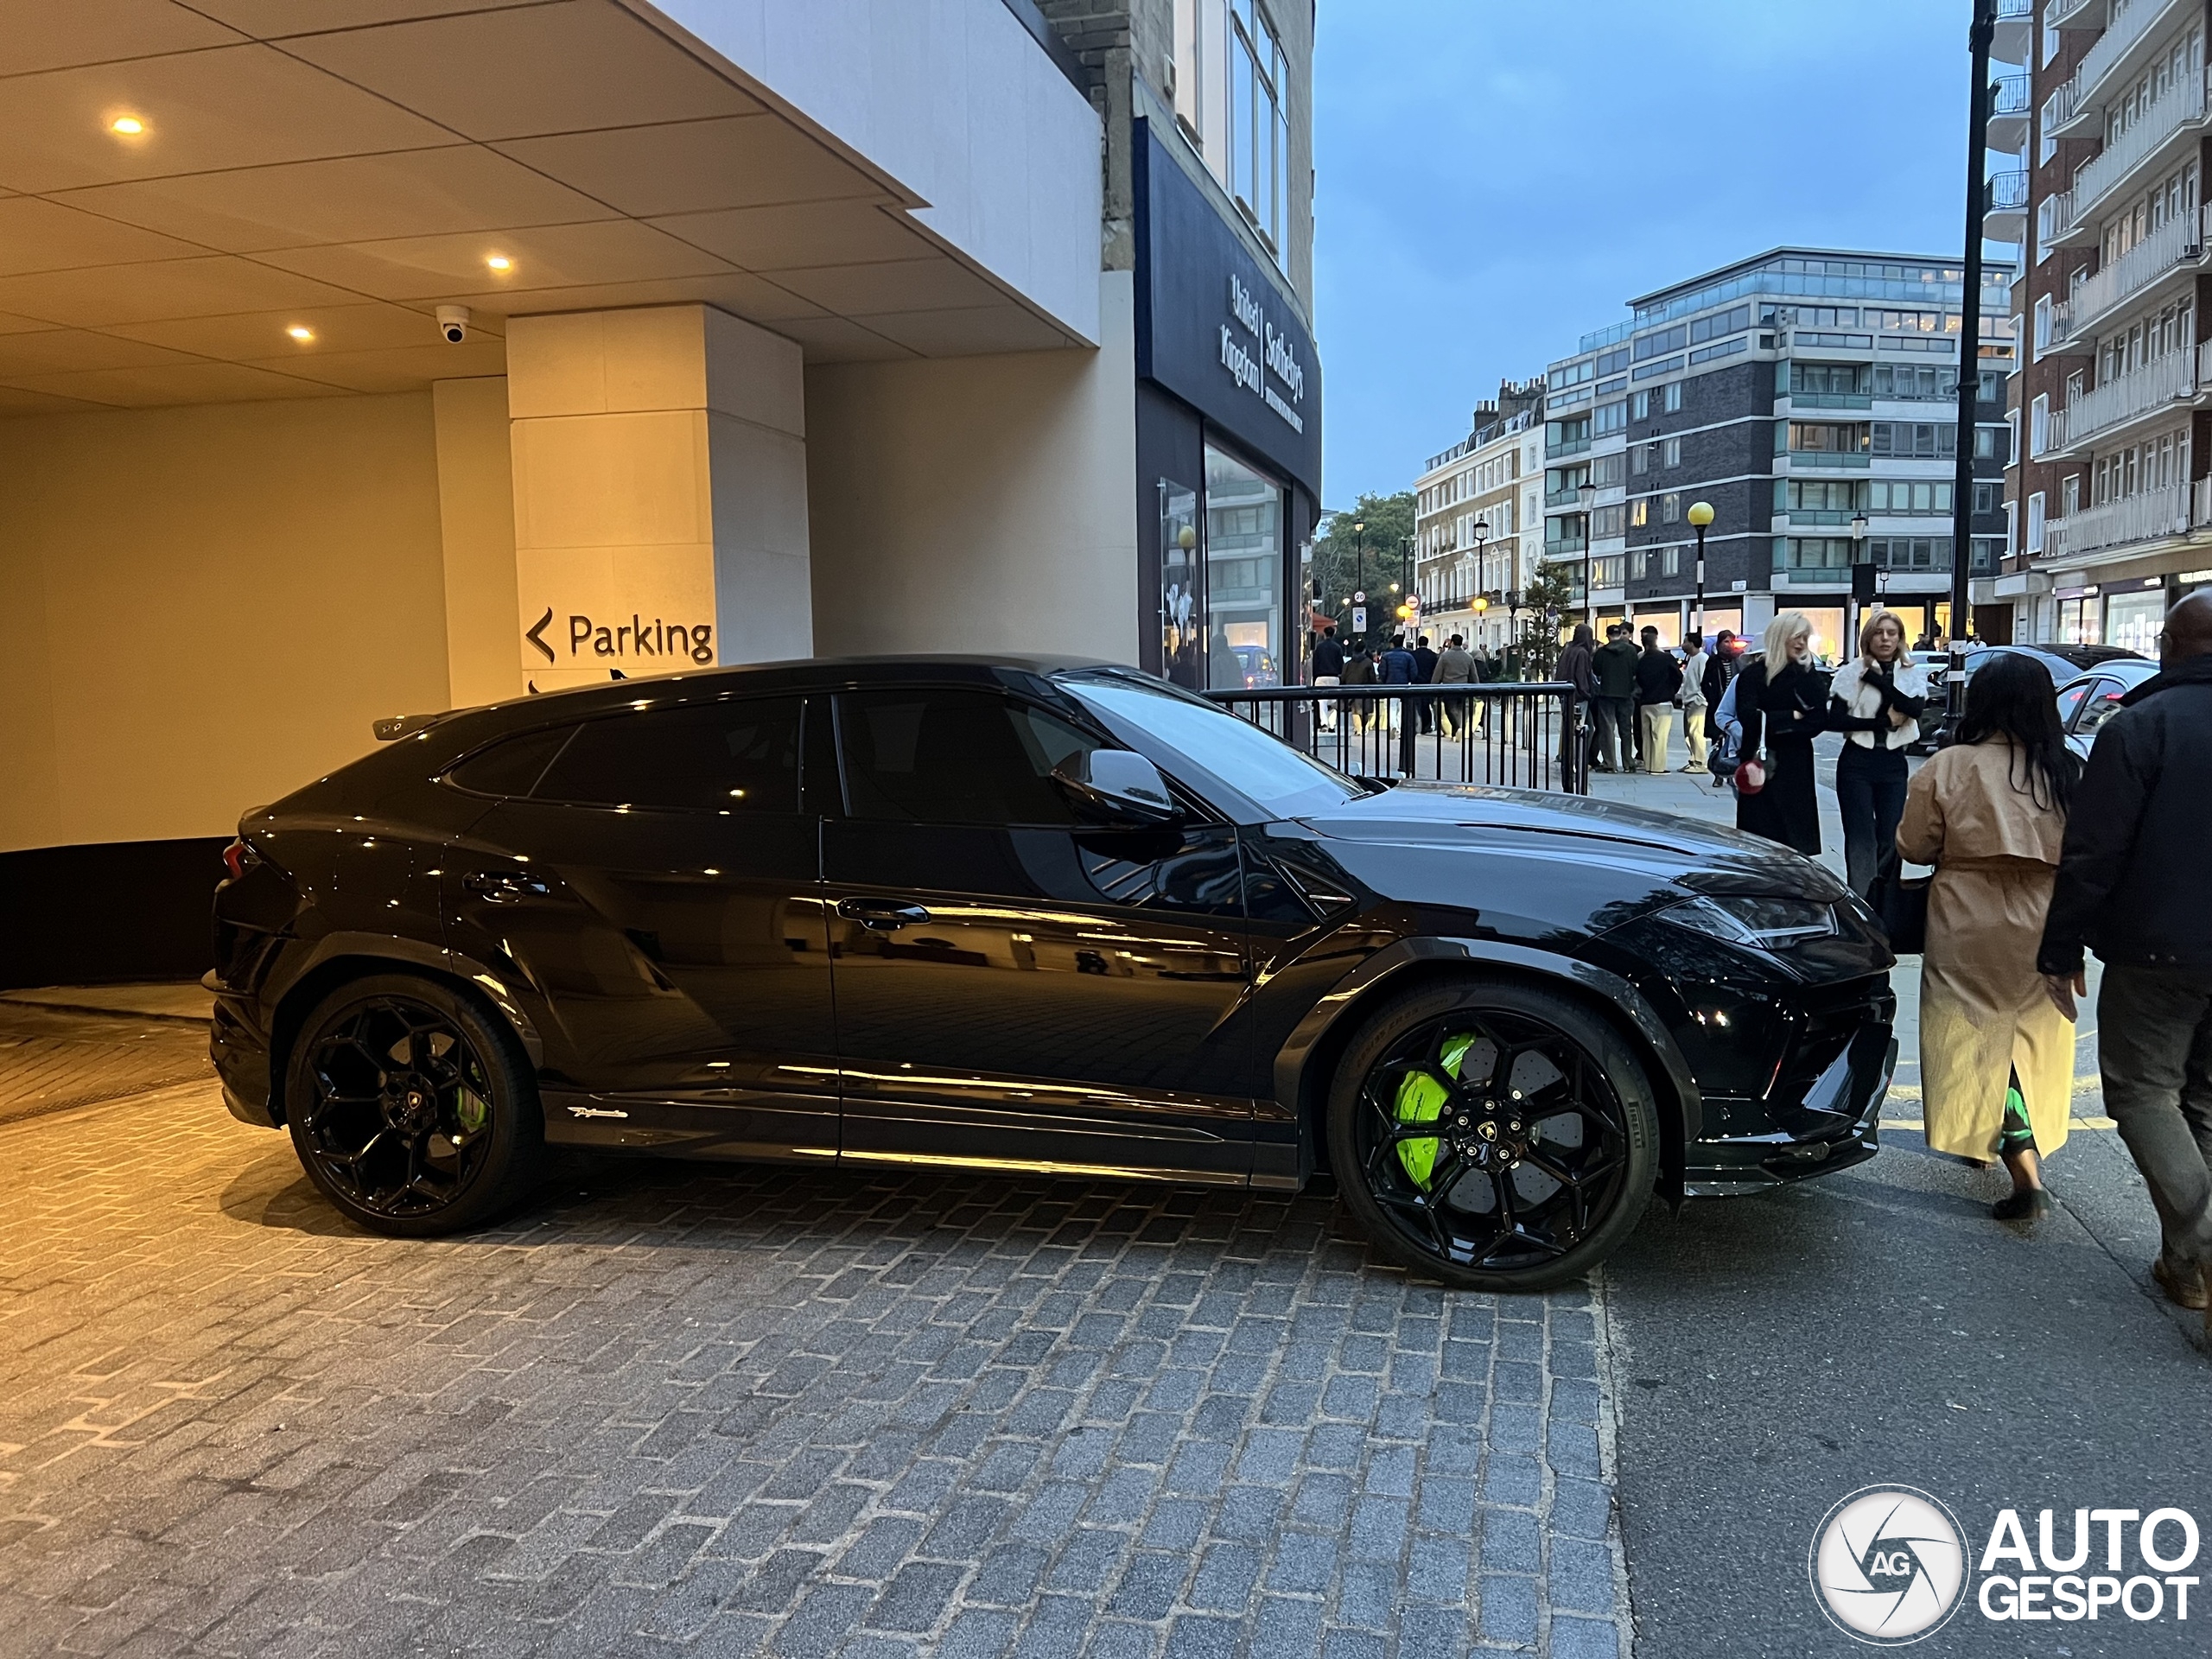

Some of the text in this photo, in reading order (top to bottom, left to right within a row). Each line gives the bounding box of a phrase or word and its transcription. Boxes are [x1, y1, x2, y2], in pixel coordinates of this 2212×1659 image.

[1230, 274, 1259, 338] United
[1219, 323, 1260, 393] Kingdom
[569, 613, 713, 665] Parking
[1628, 1102, 1646, 1148] PIRELLI
